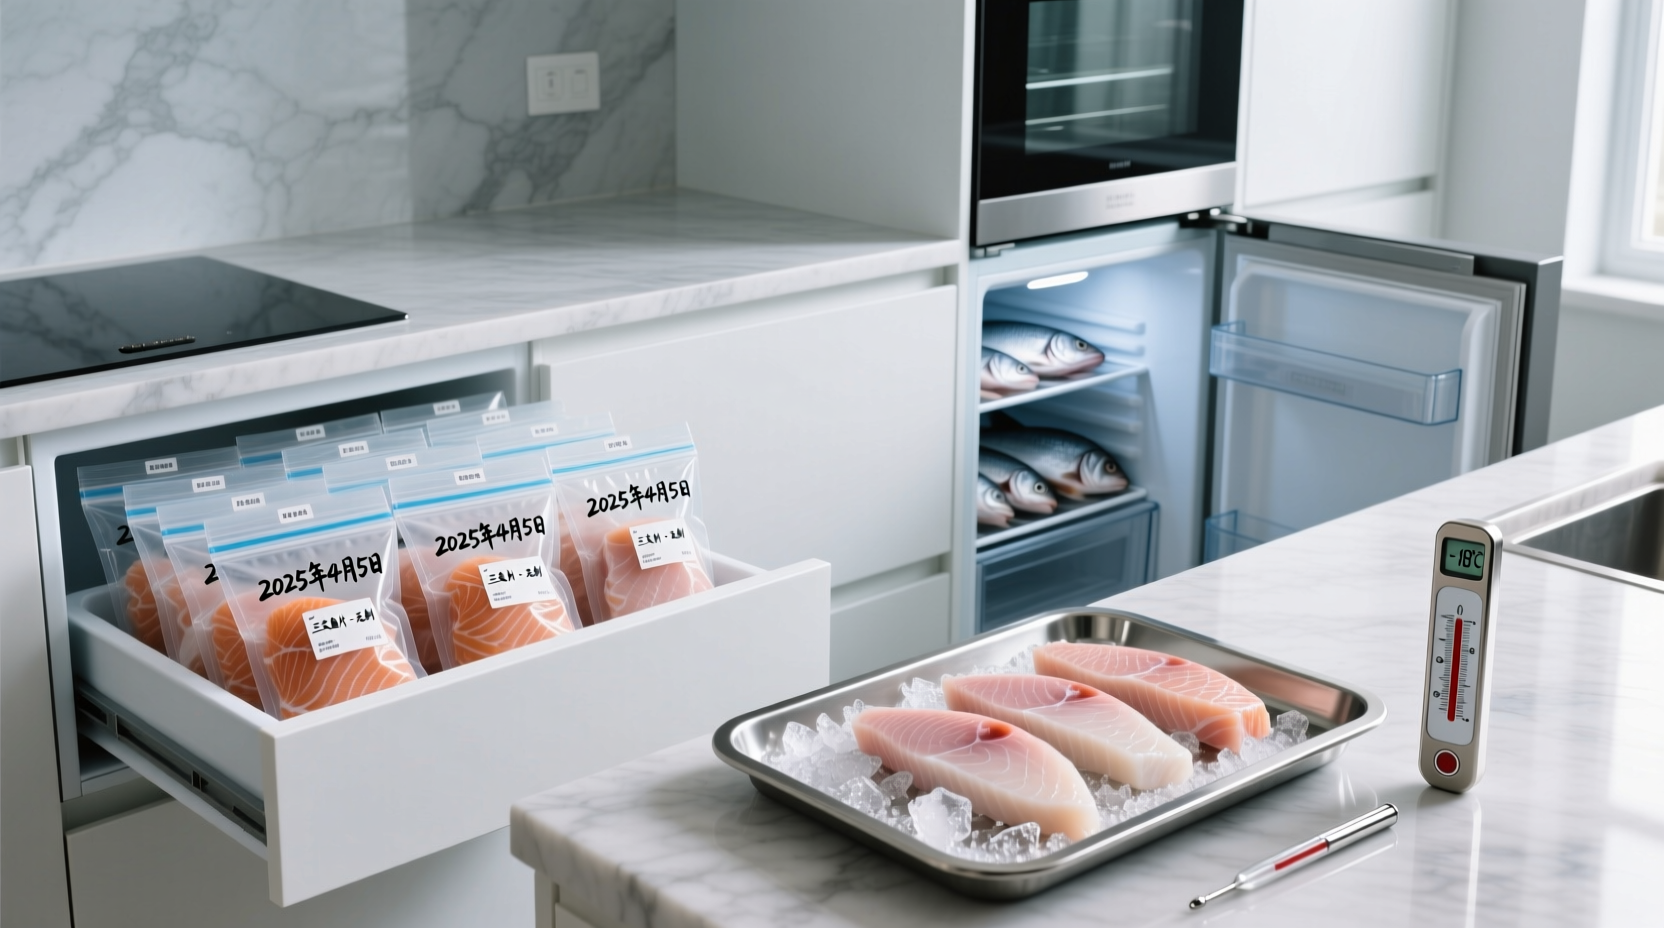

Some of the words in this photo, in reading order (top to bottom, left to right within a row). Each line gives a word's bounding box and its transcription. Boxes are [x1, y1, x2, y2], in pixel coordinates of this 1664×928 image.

[586, 480, 691, 517] 2025年4月5日
[434, 515, 546, 557] 2025年4月5日
[258, 552, 383, 602] 2025年4月5日
